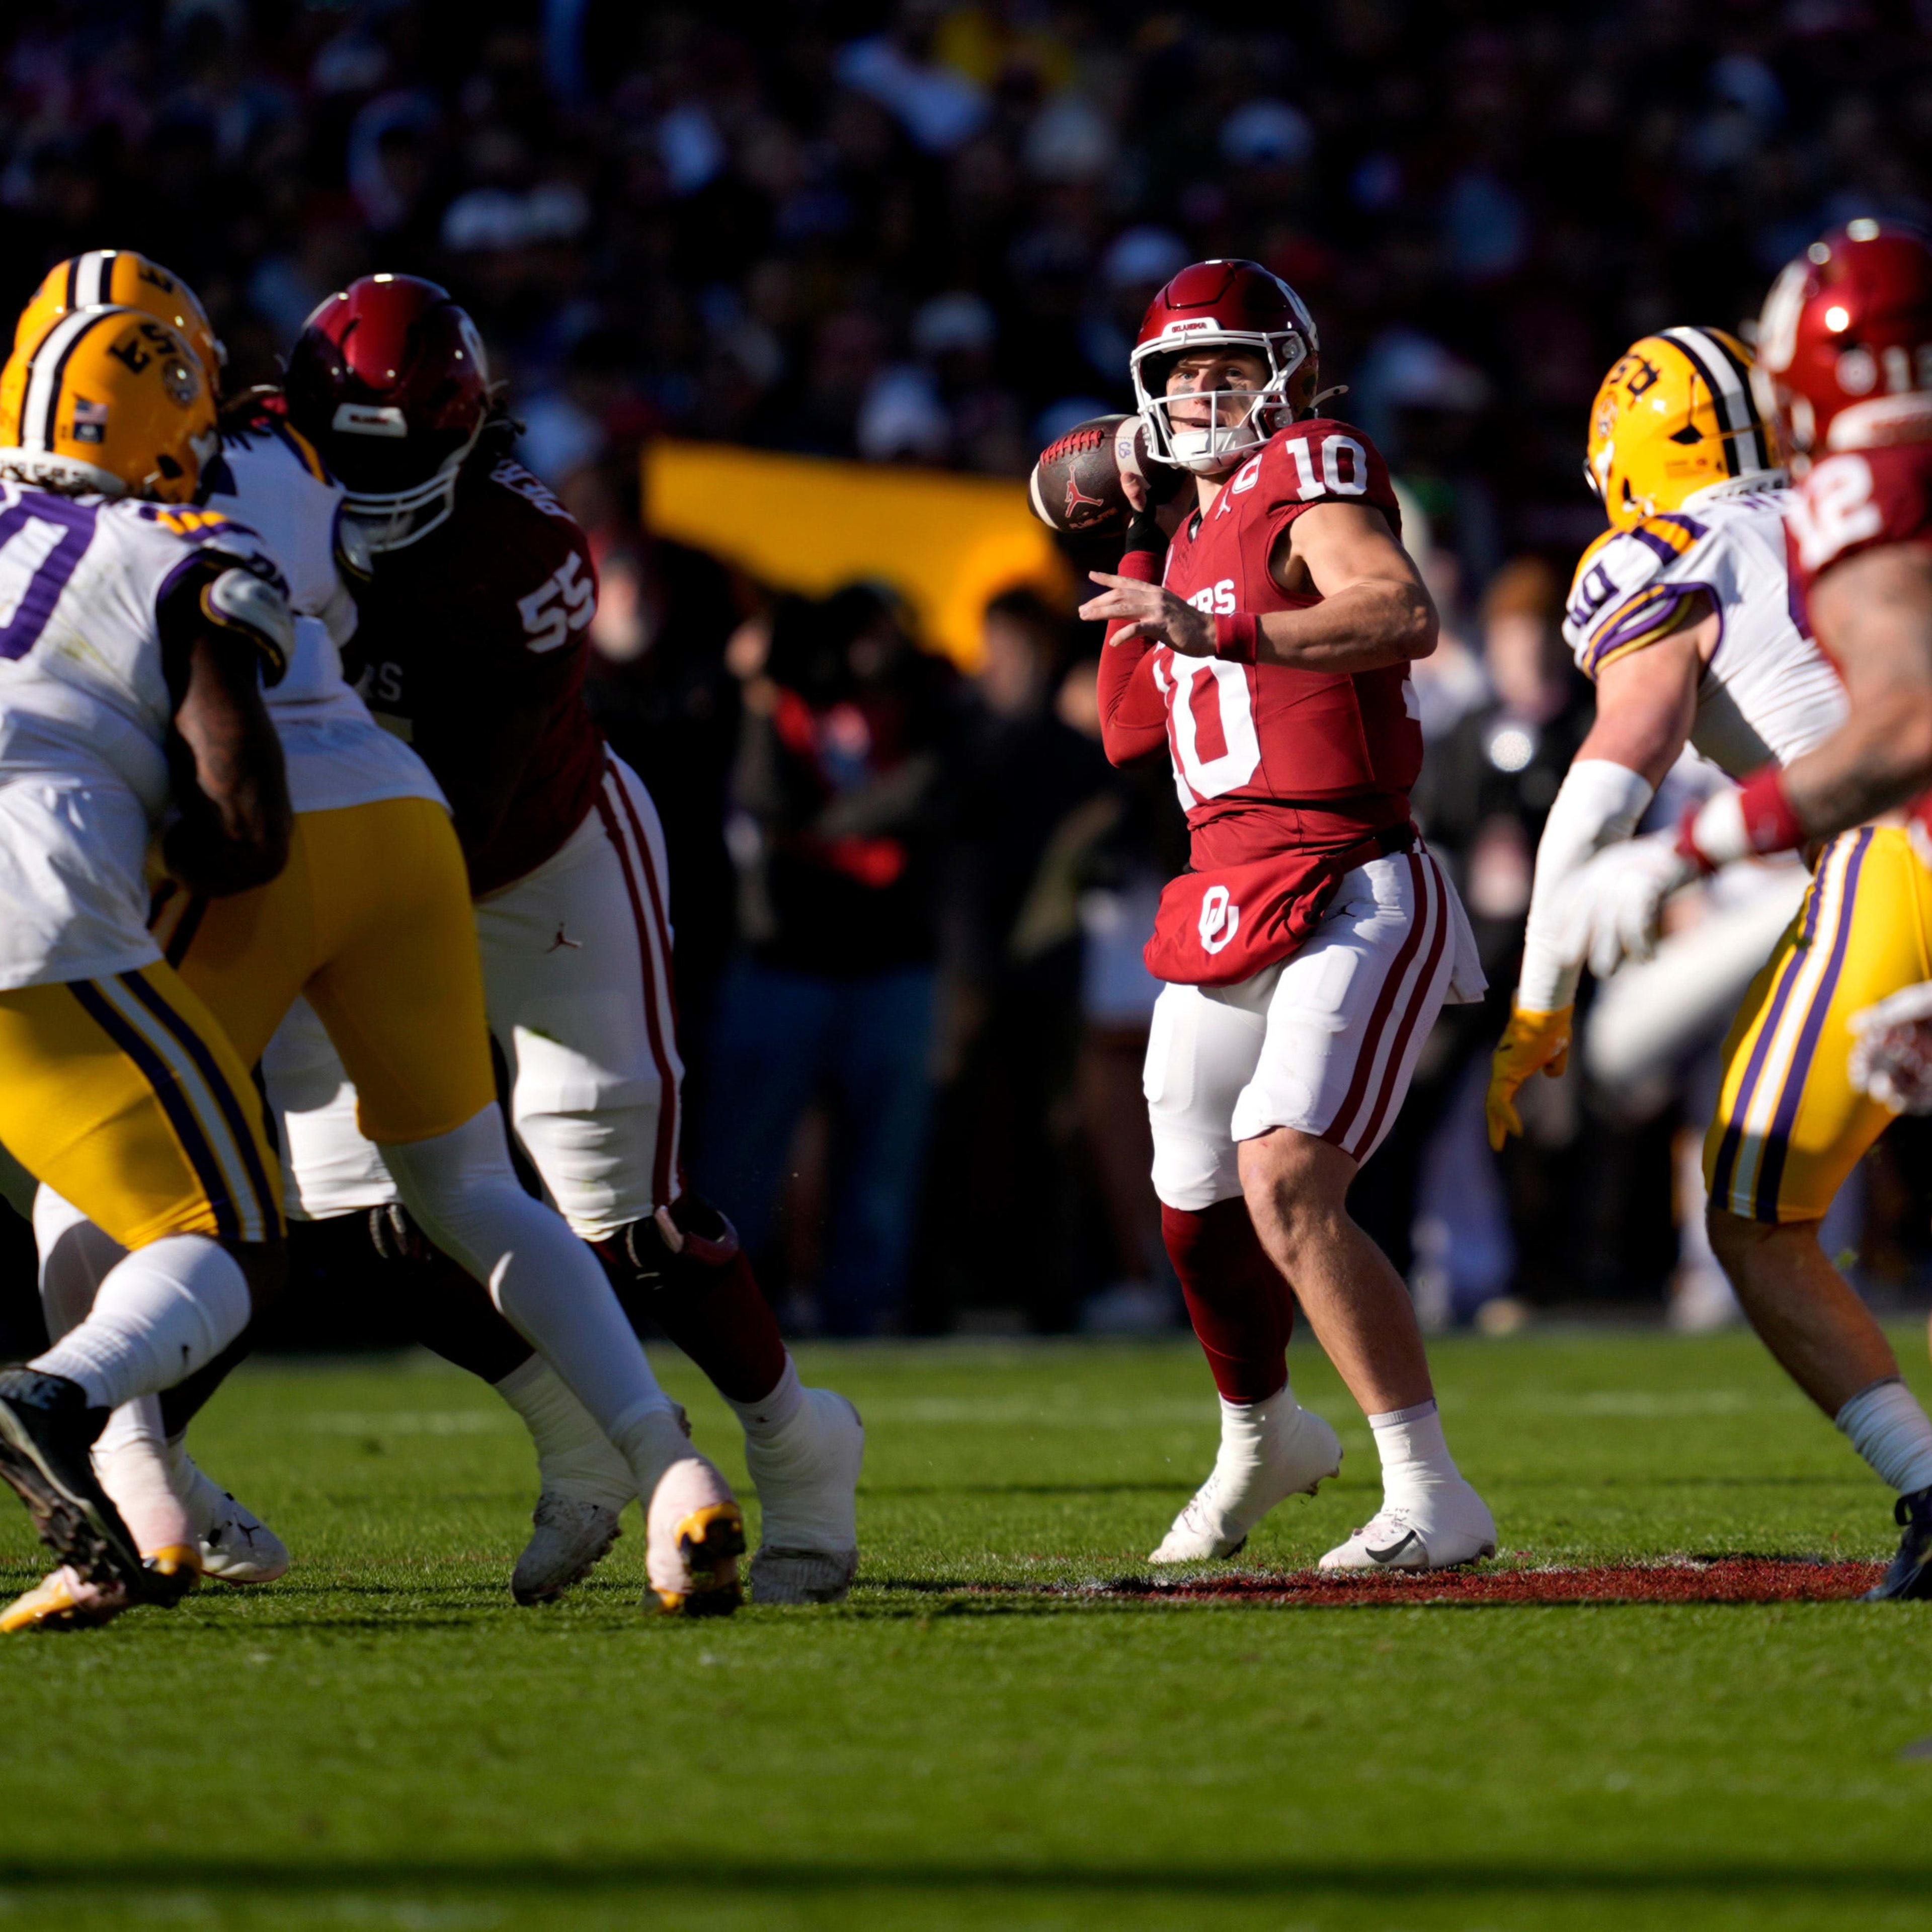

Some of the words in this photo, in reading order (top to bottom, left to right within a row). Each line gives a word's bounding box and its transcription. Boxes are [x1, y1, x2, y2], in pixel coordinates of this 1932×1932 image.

[1232, 454, 1262, 494] C
[1285, 435, 1367, 502] 10
[516, 548, 596, 654] 55
